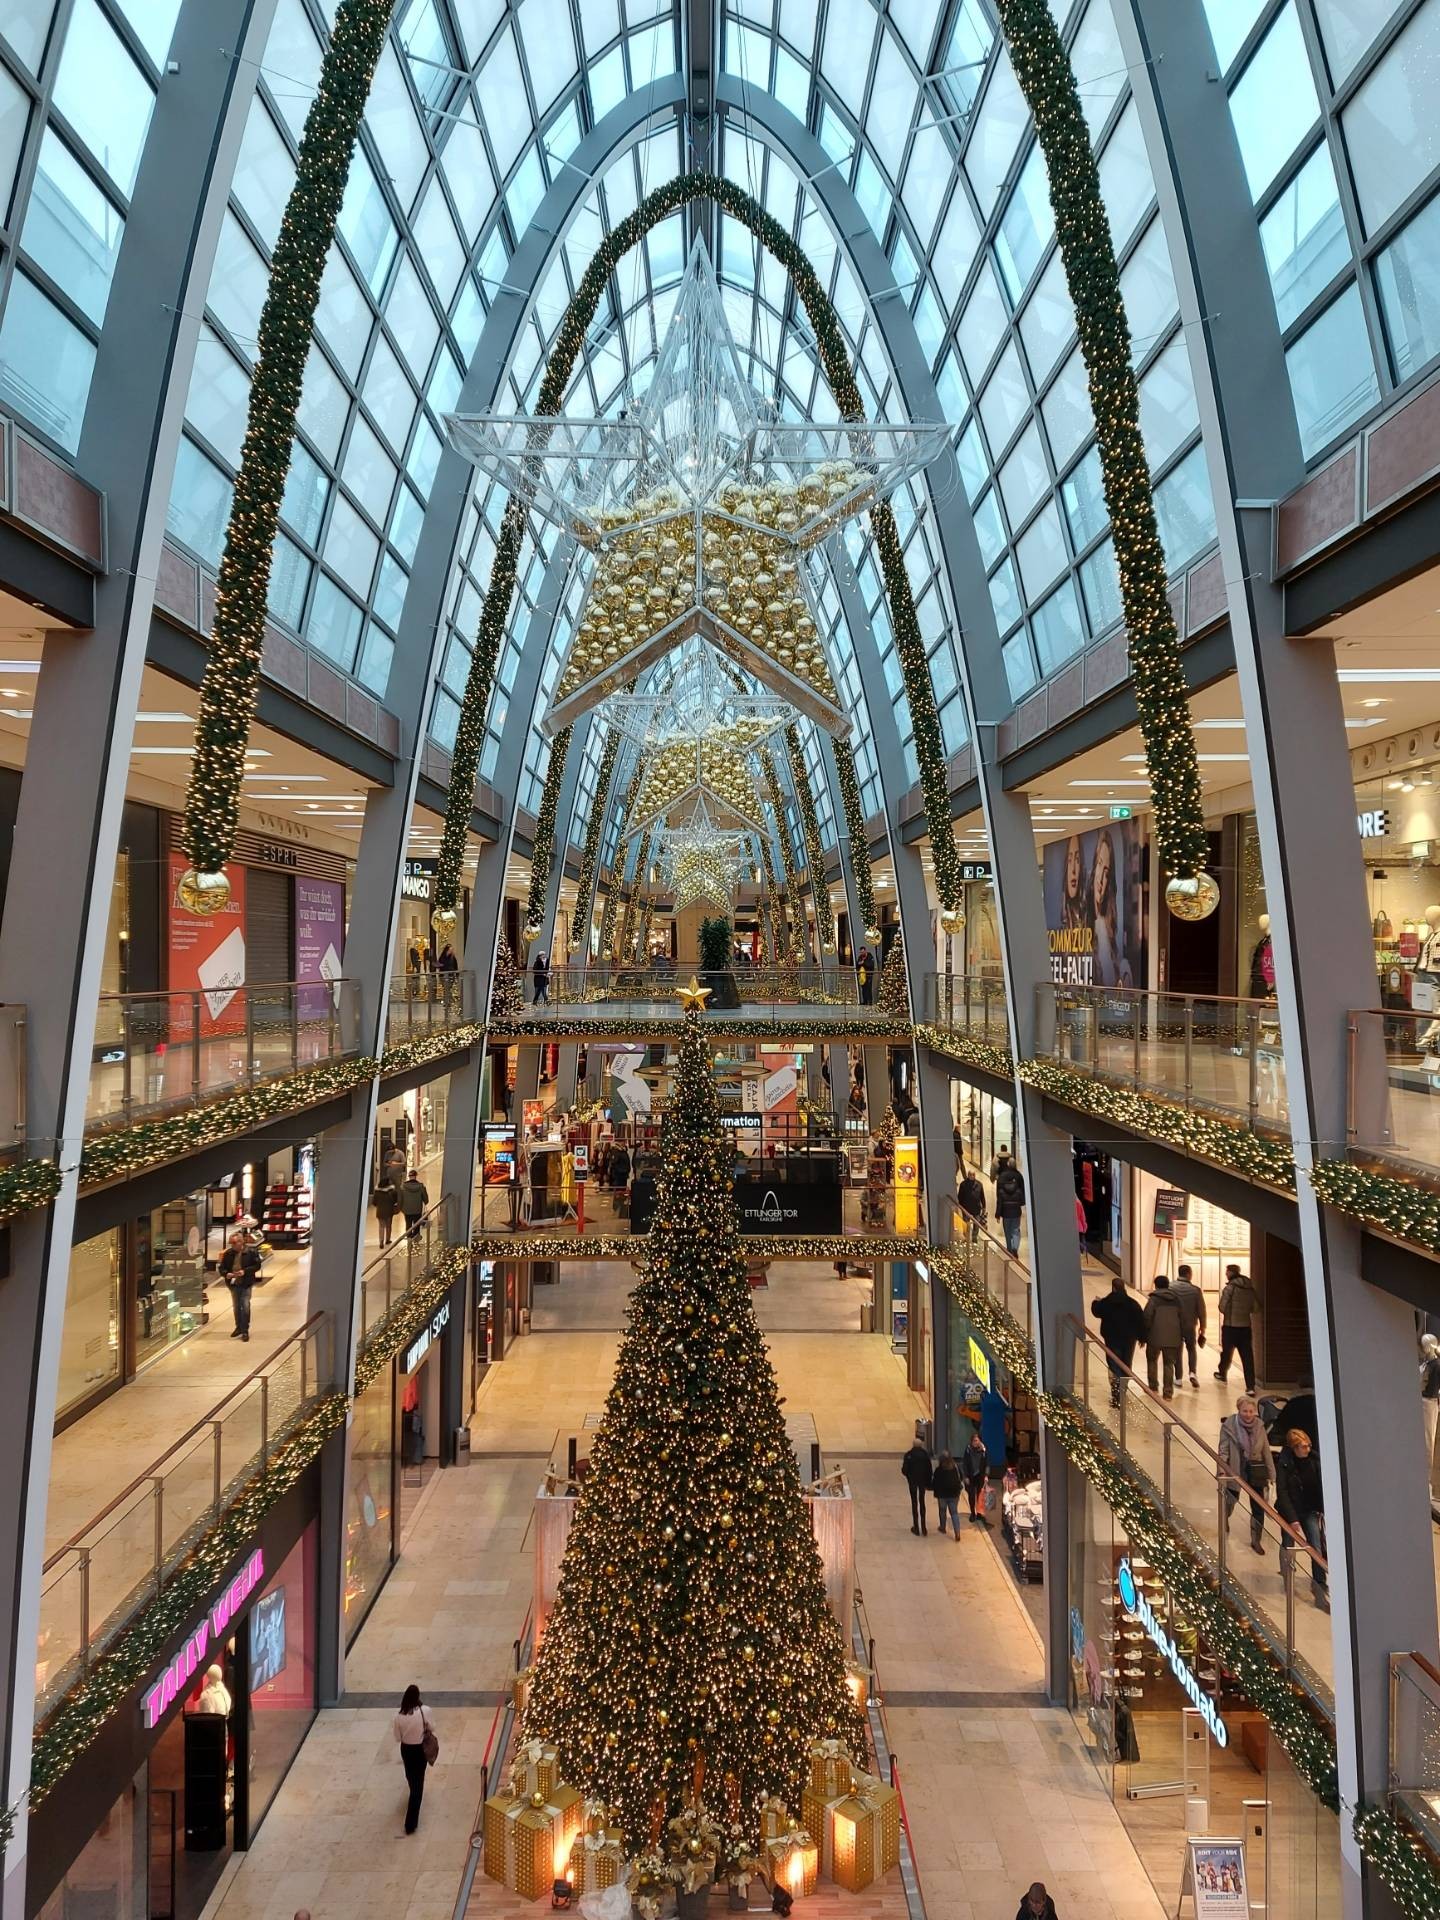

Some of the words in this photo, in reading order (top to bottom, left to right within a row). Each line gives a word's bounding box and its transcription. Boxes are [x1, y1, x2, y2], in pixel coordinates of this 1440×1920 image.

[402, 875, 430, 898] MANGO
[1047, 929, 1071, 952] OMM
[720, 1116, 760, 1128] rmation
[745, 1209, 782, 1217] ETTLINGER
[783, 1209, 798, 1217] TOR
[146, 1619, 209, 1729] TALLY
